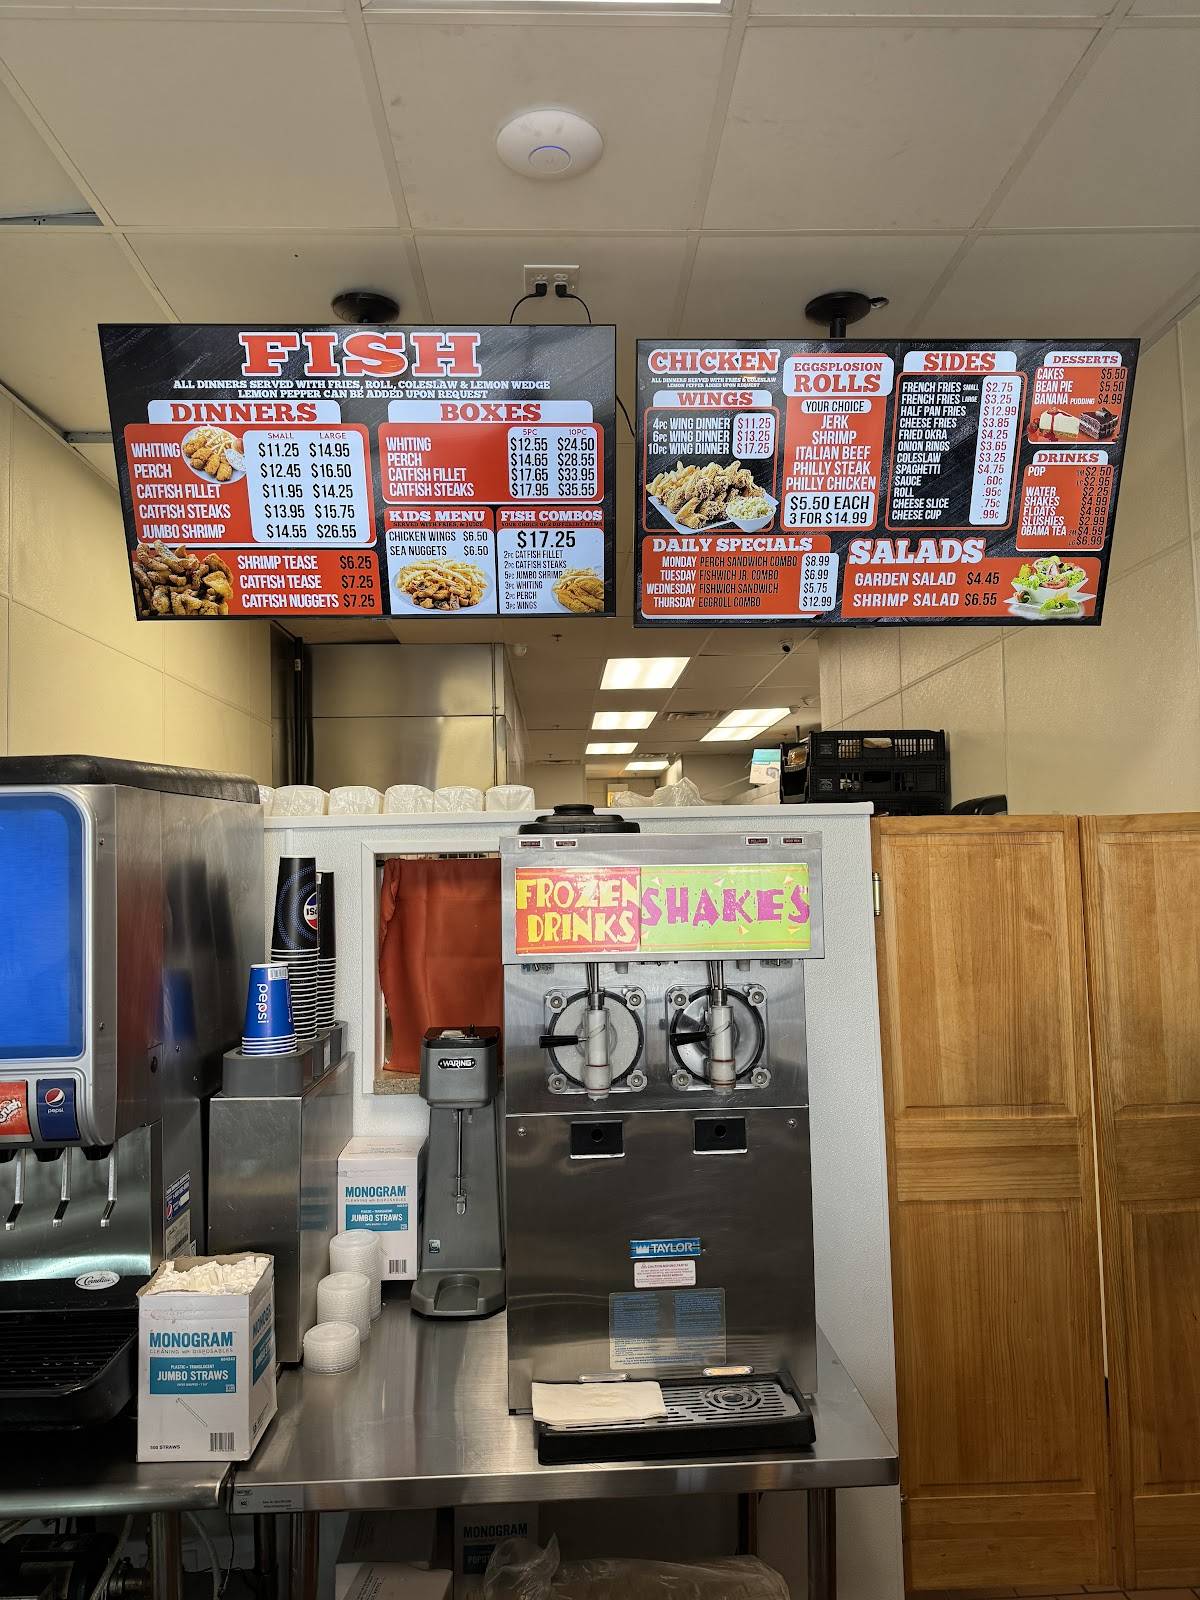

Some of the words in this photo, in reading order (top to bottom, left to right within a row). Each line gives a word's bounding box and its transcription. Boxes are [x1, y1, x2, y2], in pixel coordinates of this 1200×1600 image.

[238, 331, 482, 376] FISH
[1053, 355, 1118, 364] DESSERTS
[649, 350, 780, 373] CHICKEN
[794, 362, 882, 372] EGGSPLOSION
[923, 353, 996, 372] SIDES
[1037, 369, 1064, 380] CAKES
[1101, 369, 1126, 380] $5.50
[174, 380, 194, 389] ALL
[197, 380, 247, 389] DINNERS
[249, 380, 291, 389] SERVED
[295, 380, 326, 389] WITH
[328, 380, 363, 391] FRIES,
[365, 381, 397, 391] ROLL,
[398, 380, 458, 389] COLESLAW
[460, 381, 468, 389] &
[470, 381, 509, 389] LEMON
[511, 380, 550, 389] WEDGE
[794, 374, 881, 393] ROLLS
[1036, 381, 1058, 392] BEAN
[1060, 381, 1073, 392] PIE
[1099, 381, 1124, 392] $5.50
[238, 389, 278, 398] LEMON
[280, 389, 321, 398] PEPPER
[324, 390, 347, 399] CAN
[350, 390, 364, 399] BE
[367, 390, 403, 399] ADDED
[406, 390, 435, 399] UPON
[438, 390, 488, 399] REQUEST
[678, 392, 753, 406] WINGS
[170, 403, 318, 422] DINNERS
[440, 404, 541, 421] BOXES
[806, 401, 829, 412] YOUR
[832, 401, 864, 412] CHOICE
[900, 406, 922, 416] HALF
[923, 406, 942, 416] PAN
[943, 406, 966, 416] FRIES
[983, 406, 1017, 416] $12.99
[653, 418, 668, 430] 4PC
[670, 418, 693, 429] WING
[695, 418, 730, 430] DINNER
[737, 418, 771, 429] $11.25
[821, 415, 848, 429] JERK
[652, 431, 667, 442] 6PC
[669, 431, 693, 442] WING
[695, 430, 730, 442] DINNER
[737, 431, 770, 442] $13.25
[812, 431, 856, 445] SHRIMP
[131, 443, 180, 457] WHITING
[258, 443, 299, 458] $11.25
[309, 443, 350, 458] $14.95
[386, 437, 431, 451] WHITING
[510, 438, 548, 452] $12.55
[557, 438, 594, 452] $24.50
[648, 443, 668, 455] 10PC
[669, 443, 693, 454] WING
[695, 443, 729, 454] DINNER
[737, 443, 770, 454] $17.25
[388, 453, 422, 466] PERCH
[511, 453, 548, 467] $14.65
[558, 453, 595, 467] $28.55
[795, 446, 839, 460] ITALIAN
[842, 446, 871, 460] BEEF
[897, 453, 941, 463] COLESLAW
[979, 453, 1006, 463] $3.25
[1037, 453, 1100, 463] DRINKS
[134, 464, 172, 478] PERCH
[261, 463, 301, 478] $12.45
[311, 463, 351, 478] $16.50
[389, 468, 431, 482] CATFISH
[434, 468, 466, 481] FILLET
[511, 468, 548, 482] $17.65
[558, 468, 595, 482] $33.95
[793, 462, 829, 475] PHILLY
[832, 462, 870, 475] STEAK
[896, 464, 940, 474] SPAGHETTI
[977, 464, 1005, 474] $4.75
[137, 484, 184, 498] CATFISH
[186, 484, 221, 498] FILLET
[263, 484, 303, 498] $11.95
[313, 484, 353, 498] $14.25
[390, 483, 432, 497] CATFISH
[435, 483, 474, 496] STEAKS
[511, 483, 549, 497] $17.95
[558, 483, 595, 496] $35.55
[786, 477, 824, 491] PHILLY
[827, 477, 876, 490] CHICKEN
[1026, 487, 1056, 497] WATER
[1083, 487, 1109, 497] $2.25
[790, 496, 829, 511] $5.50
[834, 496, 869, 510] EACH
[1024, 497, 1060, 506] SHAKES
[1081, 497, 1108, 506] $4.99
[139, 505, 185, 519] CATFISH
[188, 504, 231, 518] STEAKS
[265, 504, 304, 518] $13.95
[315, 504, 355, 518] $15.75
[389, 511, 431, 521] KIDS
[435, 511, 485, 521] MENU
[501, 511, 535, 521] FISH
[539, 510, 603, 521] COMBOS
[790, 513, 796, 524] 3
[800, 512, 822, 523] FOR
[825, 512, 867, 524] $14.99
[142, 525, 180, 538] JUMBO
[182, 524, 225, 538] SHRIMP
[267, 524, 307, 538] $14.55
[317, 524, 357, 538] $26.55
[389, 531, 426, 541] CHICKEN
[428, 531, 456, 541] WINGS
[463, 531, 488, 542] $6.50
[517, 531, 576, 548] $17.25
[653, 538, 712, 552] DAILY
[716, 538, 813, 552] SPECIALS
[390, 546, 407, 556] SEA
[408, 546, 447, 556] NUGGETS
[463, 546, 488, 556] $6.50
[848, 539, 986, 564] SALADS
[238, 556, 280, 570] SHRIMP
[282, 556, 318, 570] TEASE
[340, 556, 372, 570] $6.25
[240, 575, 285, 589] CATFISH
[287, 575, 322, 588] TEASE
[341, 575, 373, 588] $7.25
[854, 573, 910, 586] GARDEN
[912, 573, 956, 585] SALAD
[967, 573, 999, 585] $4.45
[242, 594, 288, 608] CATFISH
[289, 594, 339, 608] NUGGETS
[343, 594, 375, 608] $7.25
[853, 594, 908, 607] SHRIMP
[913, 593, 959, 606] SALAD
[965, 593, 997, 606] $6.55
[516, 877, 641, 910] FROZEN
[640, 885, 810, 926] SHAKES
[528, 908, 637, 943] DRINKS
[257, 984, 270, 1023] pepsi
[443, 1059, 472, 1067] WARING
[346, 1186, 406, 1197] MONOGRAM
[351, 1214, 373, 1222] JUMBO
[651, 1243, 693, 1253] TAYLOR
[150, 1332, 233, 1347] MONOGRAM
[157, 1371, 187, 1381] JUMBO
[191, 1370, 228, 1380] STRAWS
[463, 1523, 528, 1538] MONOGRAM
